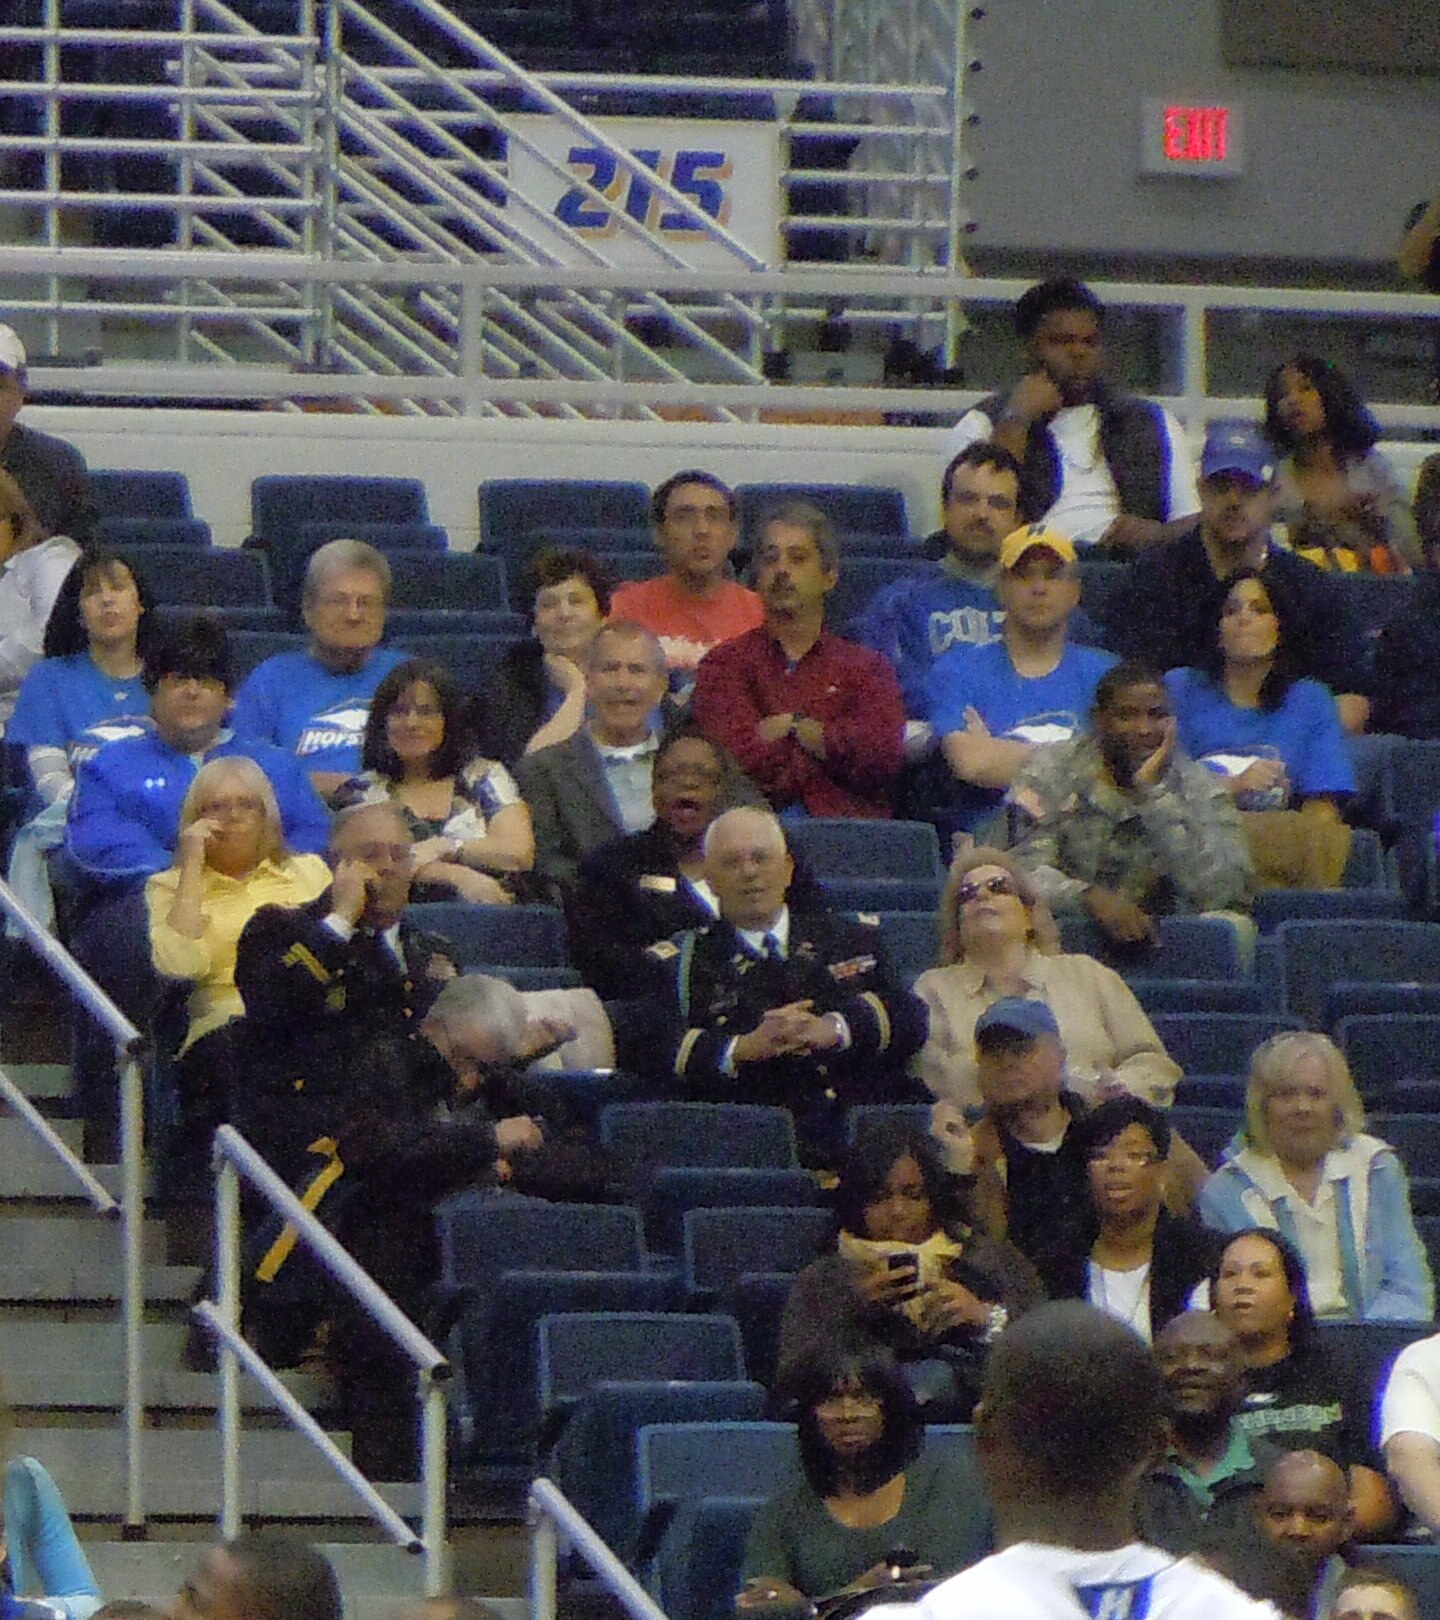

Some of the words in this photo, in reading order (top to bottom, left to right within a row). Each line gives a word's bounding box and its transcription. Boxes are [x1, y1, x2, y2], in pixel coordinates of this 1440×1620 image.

[1164, 106, 1227, 160] EXIT
[554, 147, 734, 240] 215
[300, 730, 366, 754] HOFS
